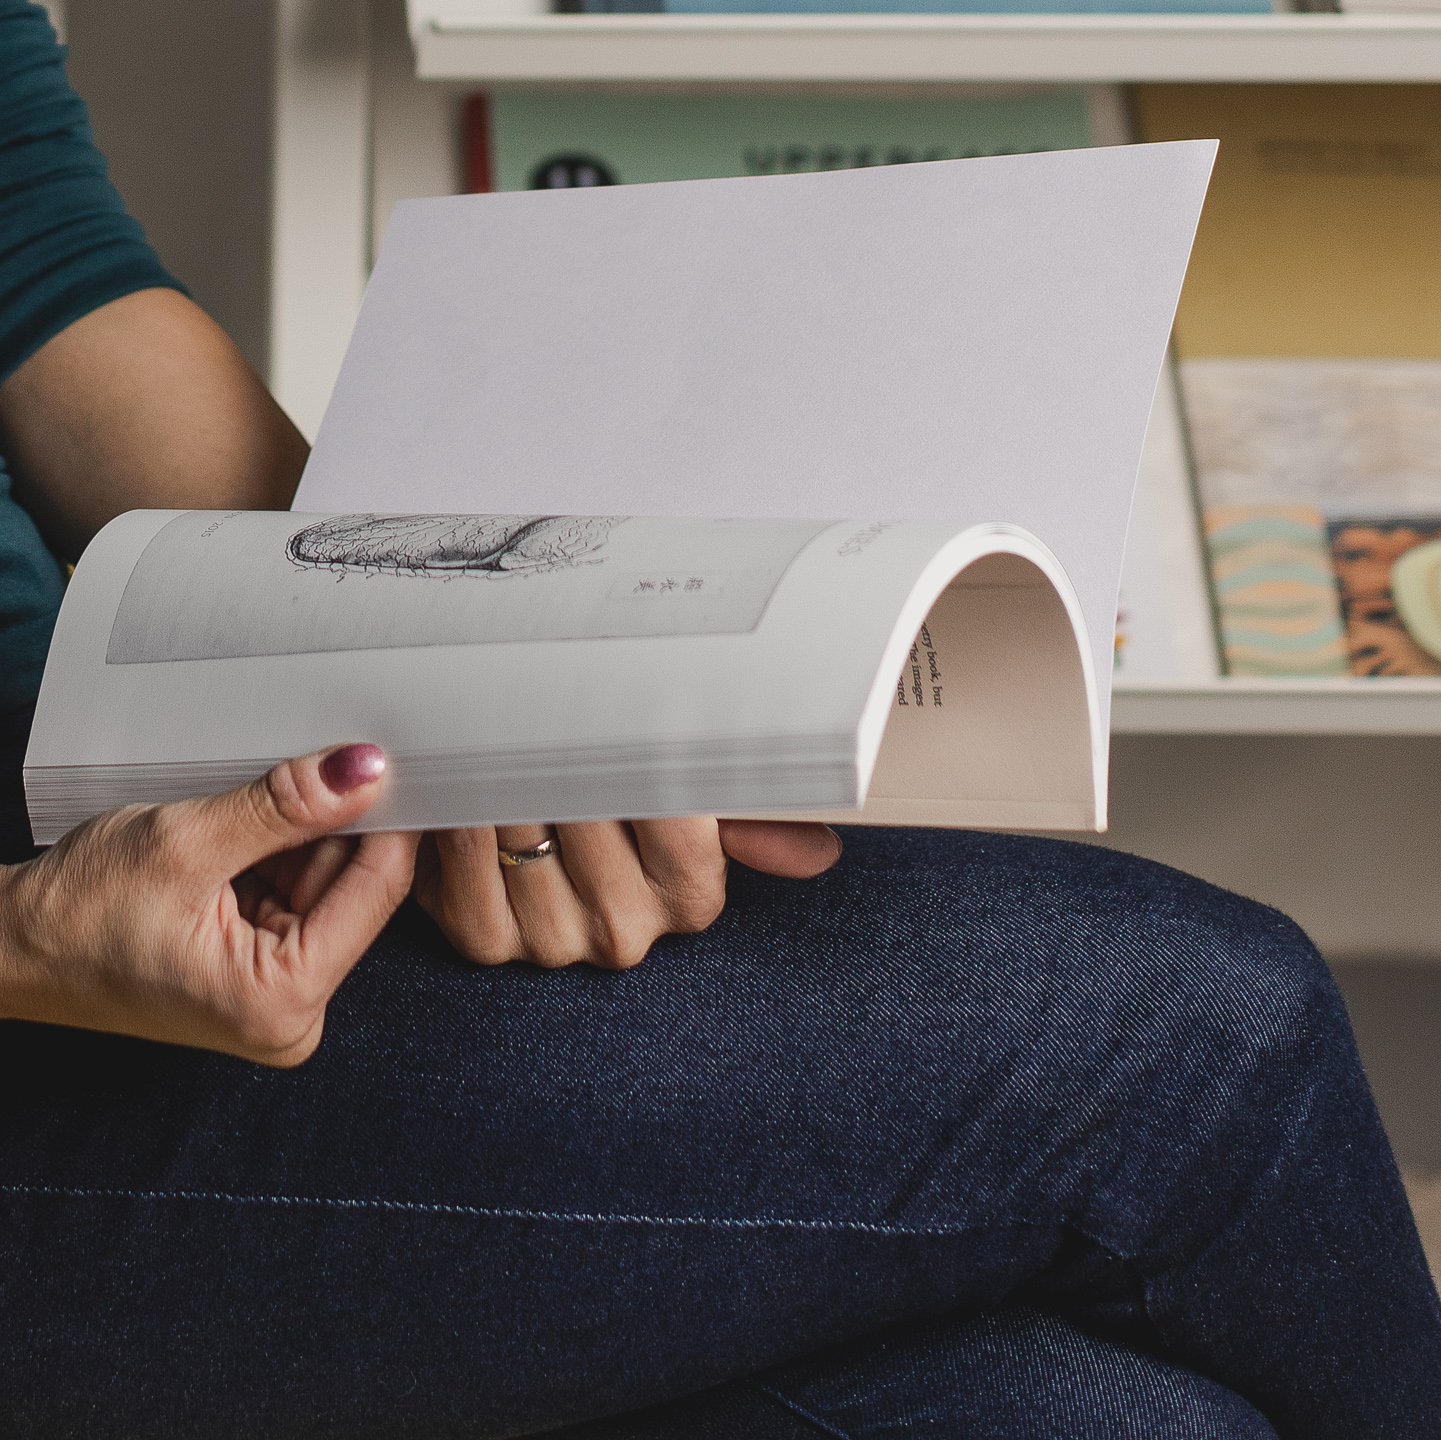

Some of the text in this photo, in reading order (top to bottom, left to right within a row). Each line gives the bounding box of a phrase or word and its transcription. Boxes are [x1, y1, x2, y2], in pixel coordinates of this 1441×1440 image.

[200, 521, 224, 538] 2015
[912, 664, 924, 707] images
[920, 621, 944, 708] etry book, but
